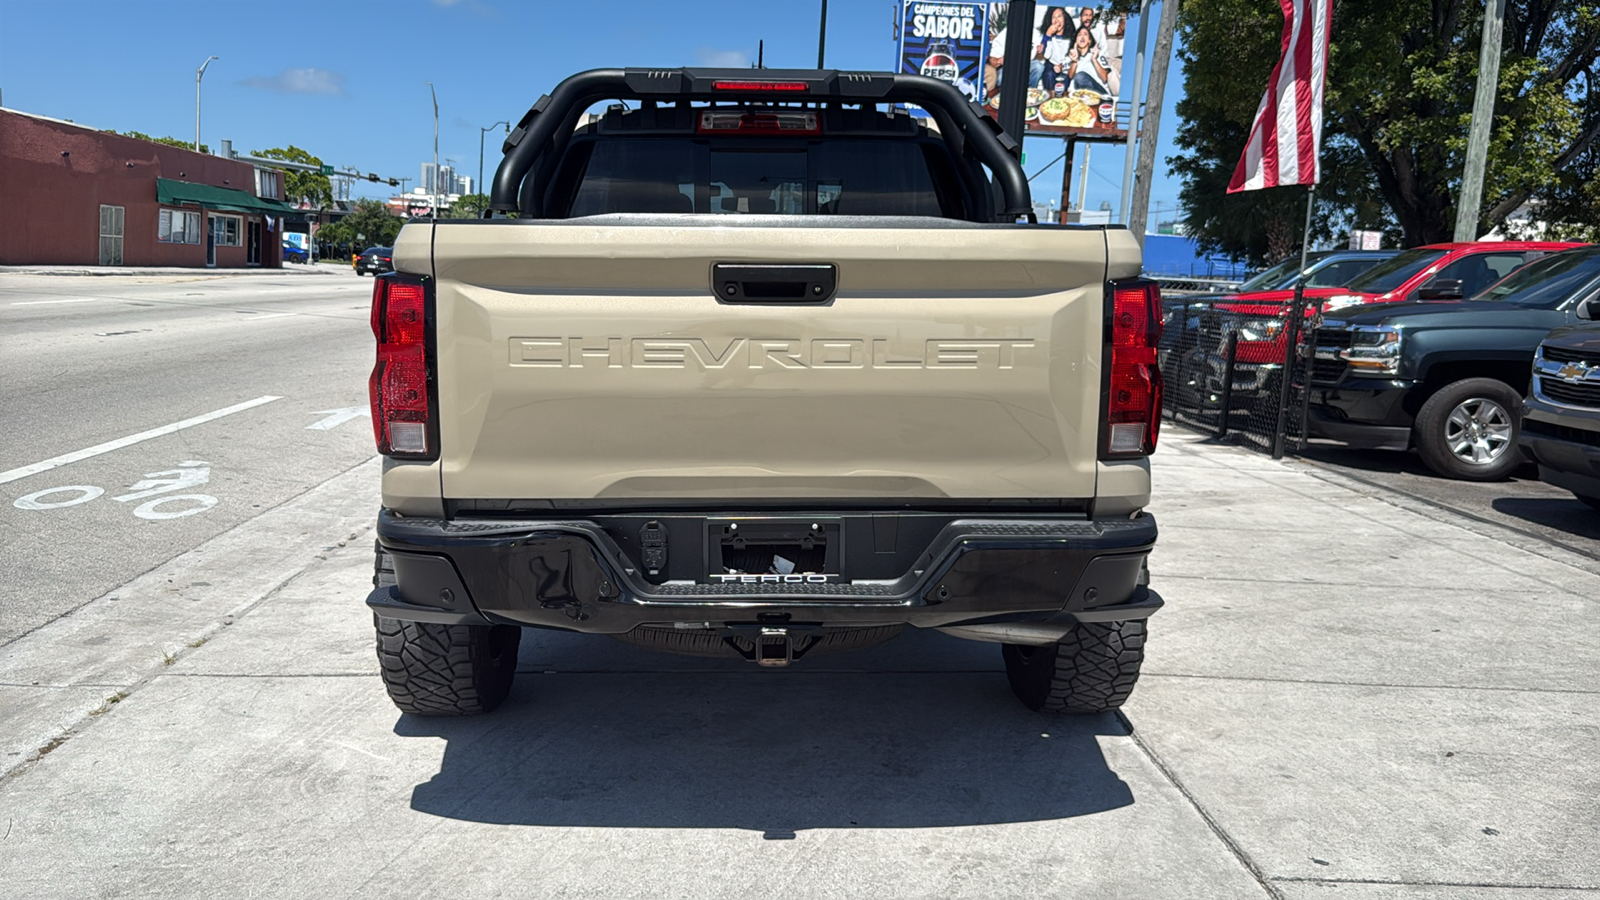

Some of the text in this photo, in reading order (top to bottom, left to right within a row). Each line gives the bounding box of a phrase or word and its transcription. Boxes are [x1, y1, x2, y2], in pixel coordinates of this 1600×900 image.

[914, 4, 975, 17] CAMPEONES DEL
[913, 15, 975, 40] SABOR
[924, 68, 956, 78] PEPSI
[508, 336, 1035, 369] CHEVROLET
[721, 574, 828, 583] FERCO
